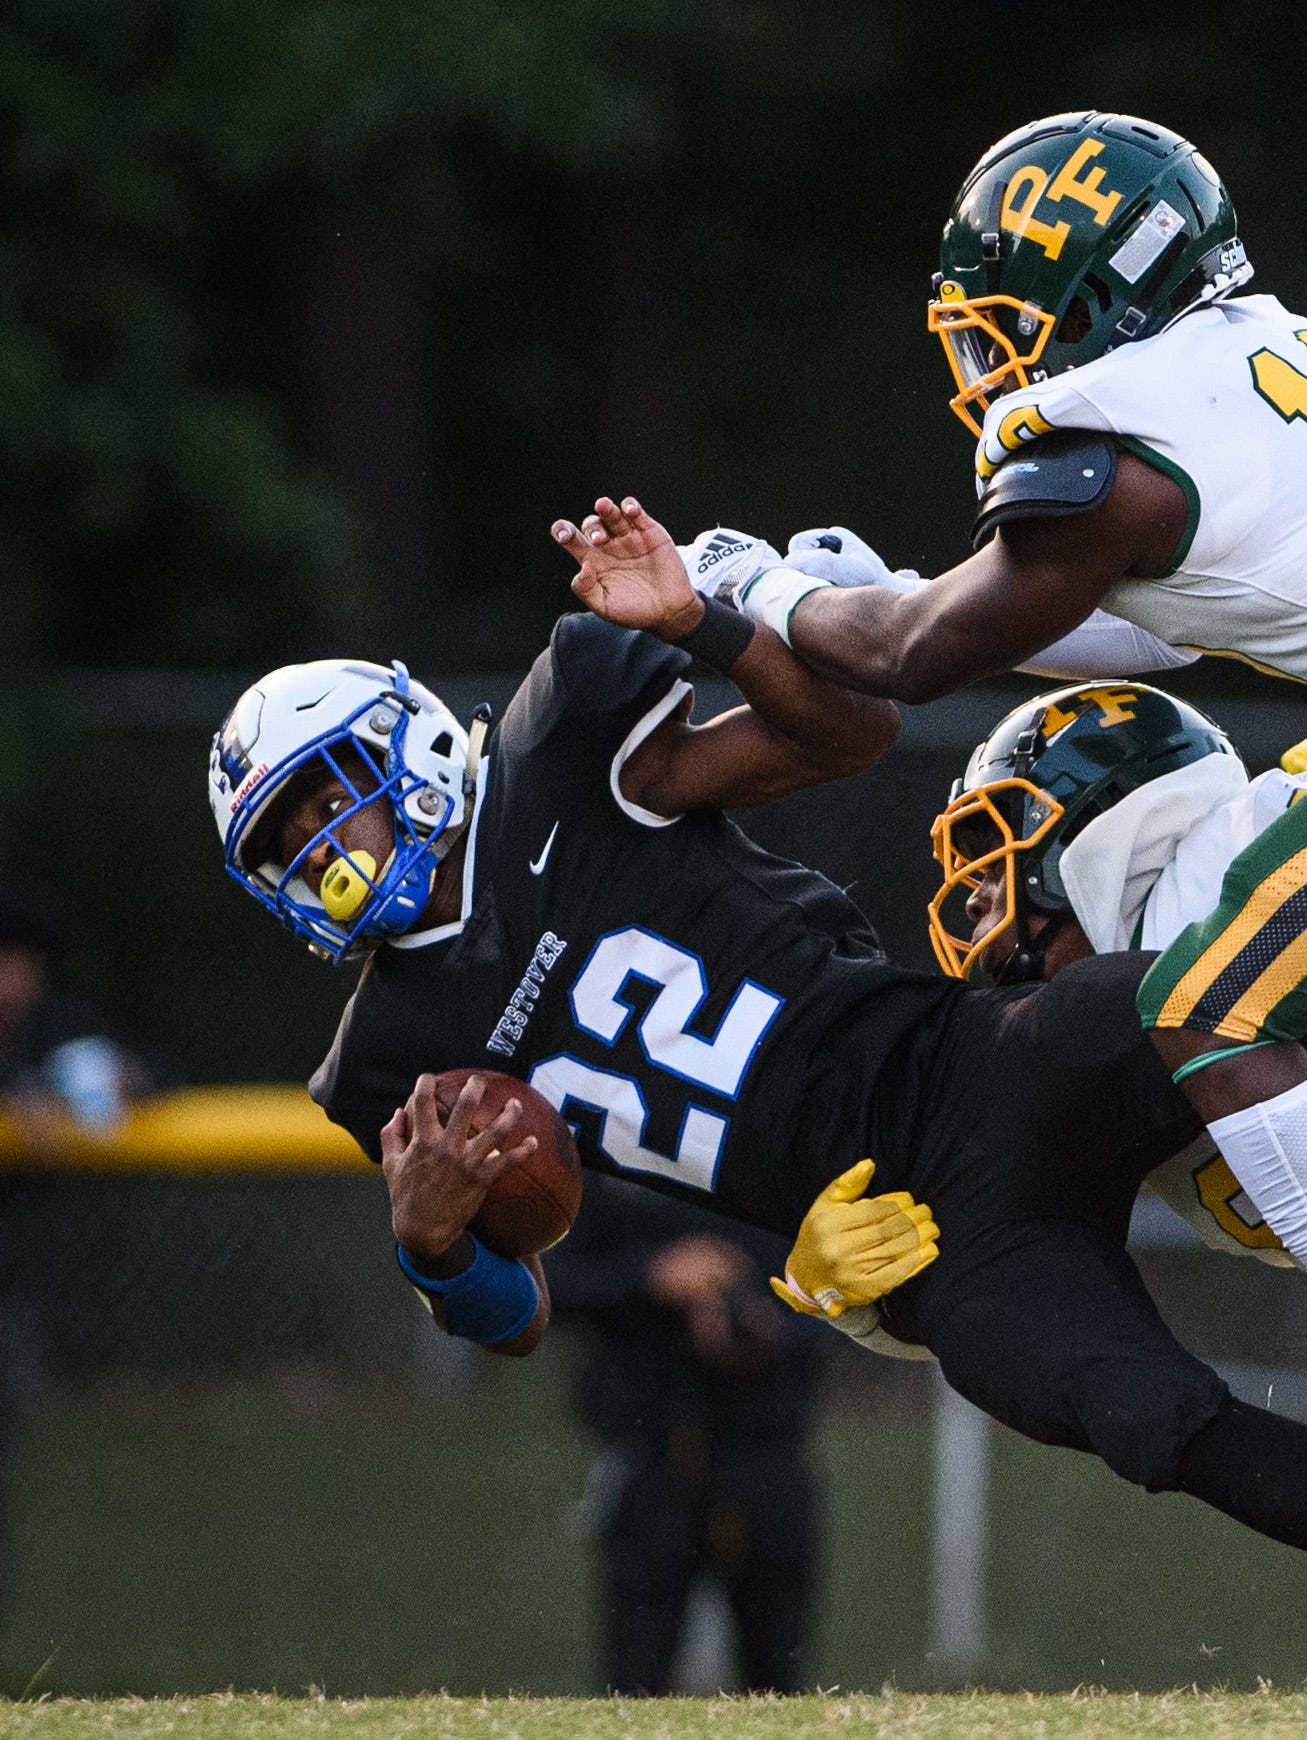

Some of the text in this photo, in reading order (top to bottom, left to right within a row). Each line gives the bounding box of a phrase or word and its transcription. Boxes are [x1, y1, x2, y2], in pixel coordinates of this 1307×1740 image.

[1000, 137, 1123, 261] PF
[486, 930, 568, 1058] WESTOVER
[527, 922, 787, 1195] 22
